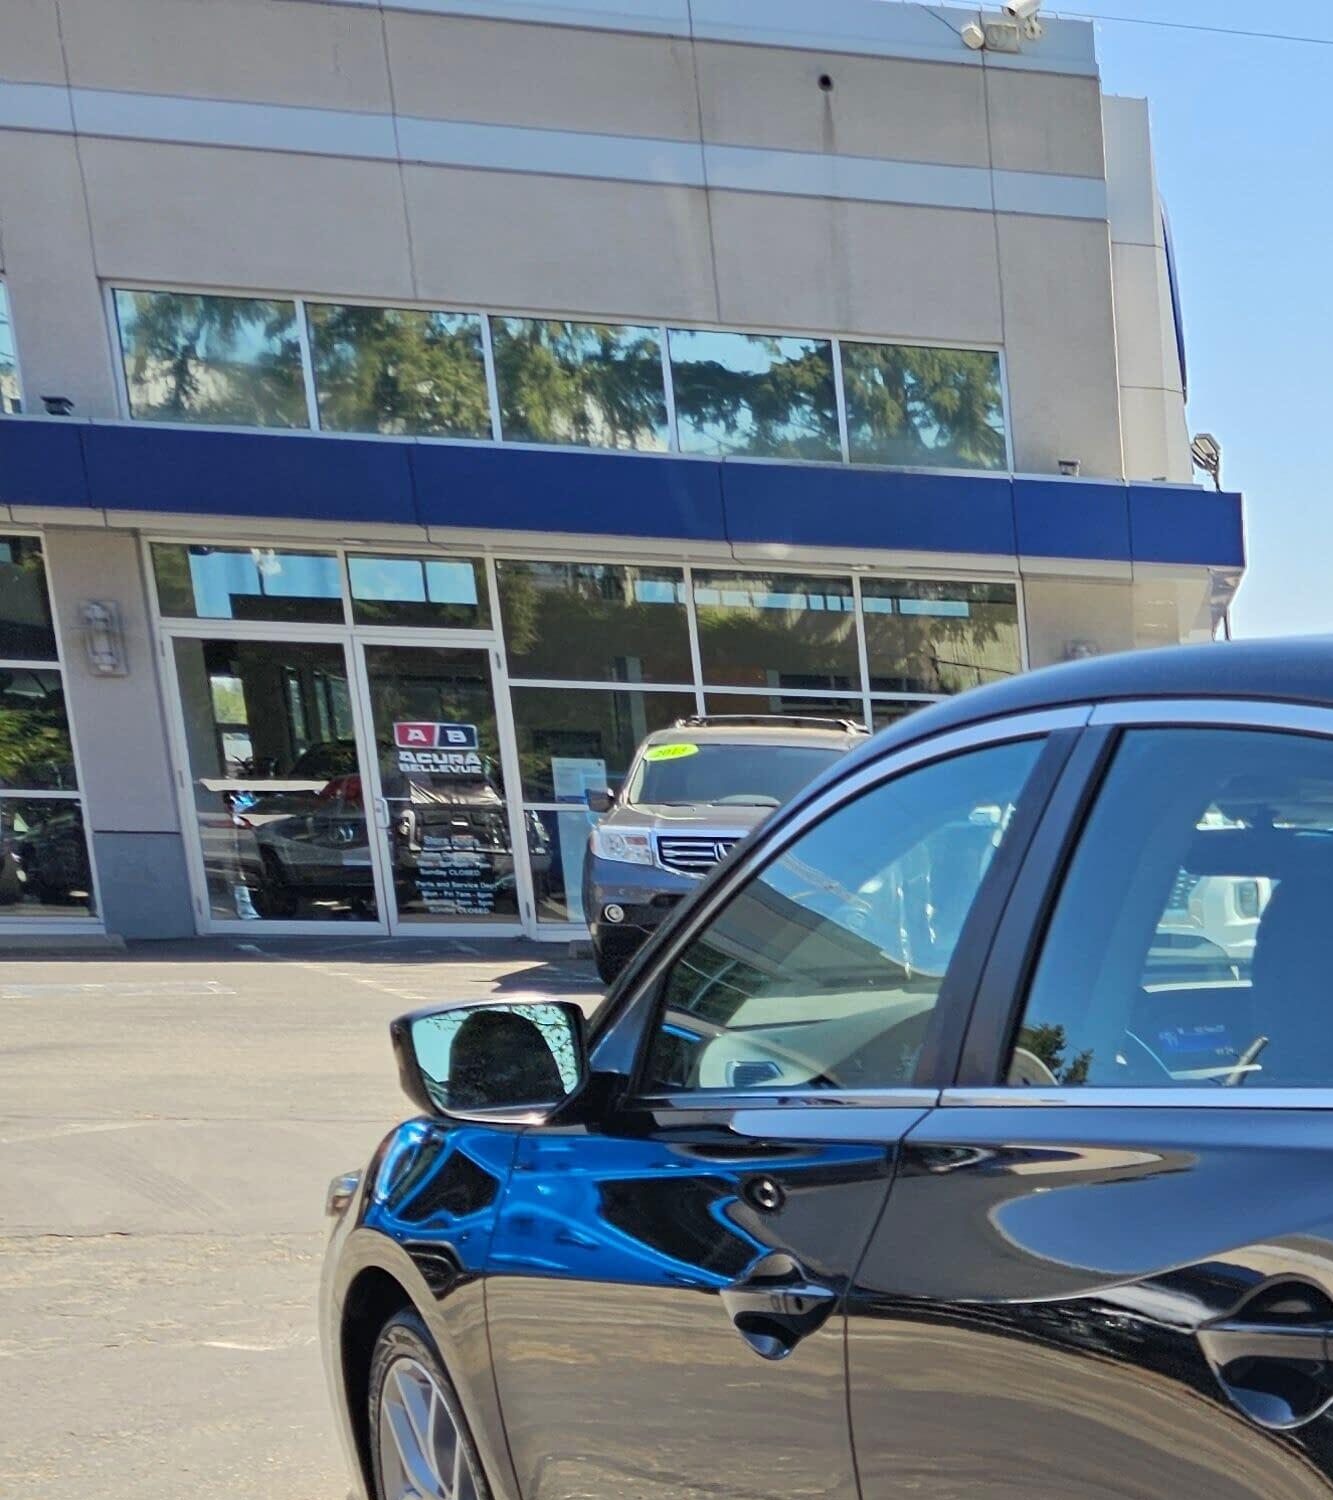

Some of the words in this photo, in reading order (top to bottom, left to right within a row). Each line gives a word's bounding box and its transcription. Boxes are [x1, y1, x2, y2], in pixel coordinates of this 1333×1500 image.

[407, 728, 428, 742] A
[446, 729, 468, 743] B
[398, 751, 482, 765] ACURA
[398, 763, 482, 775] BELLEVUE
